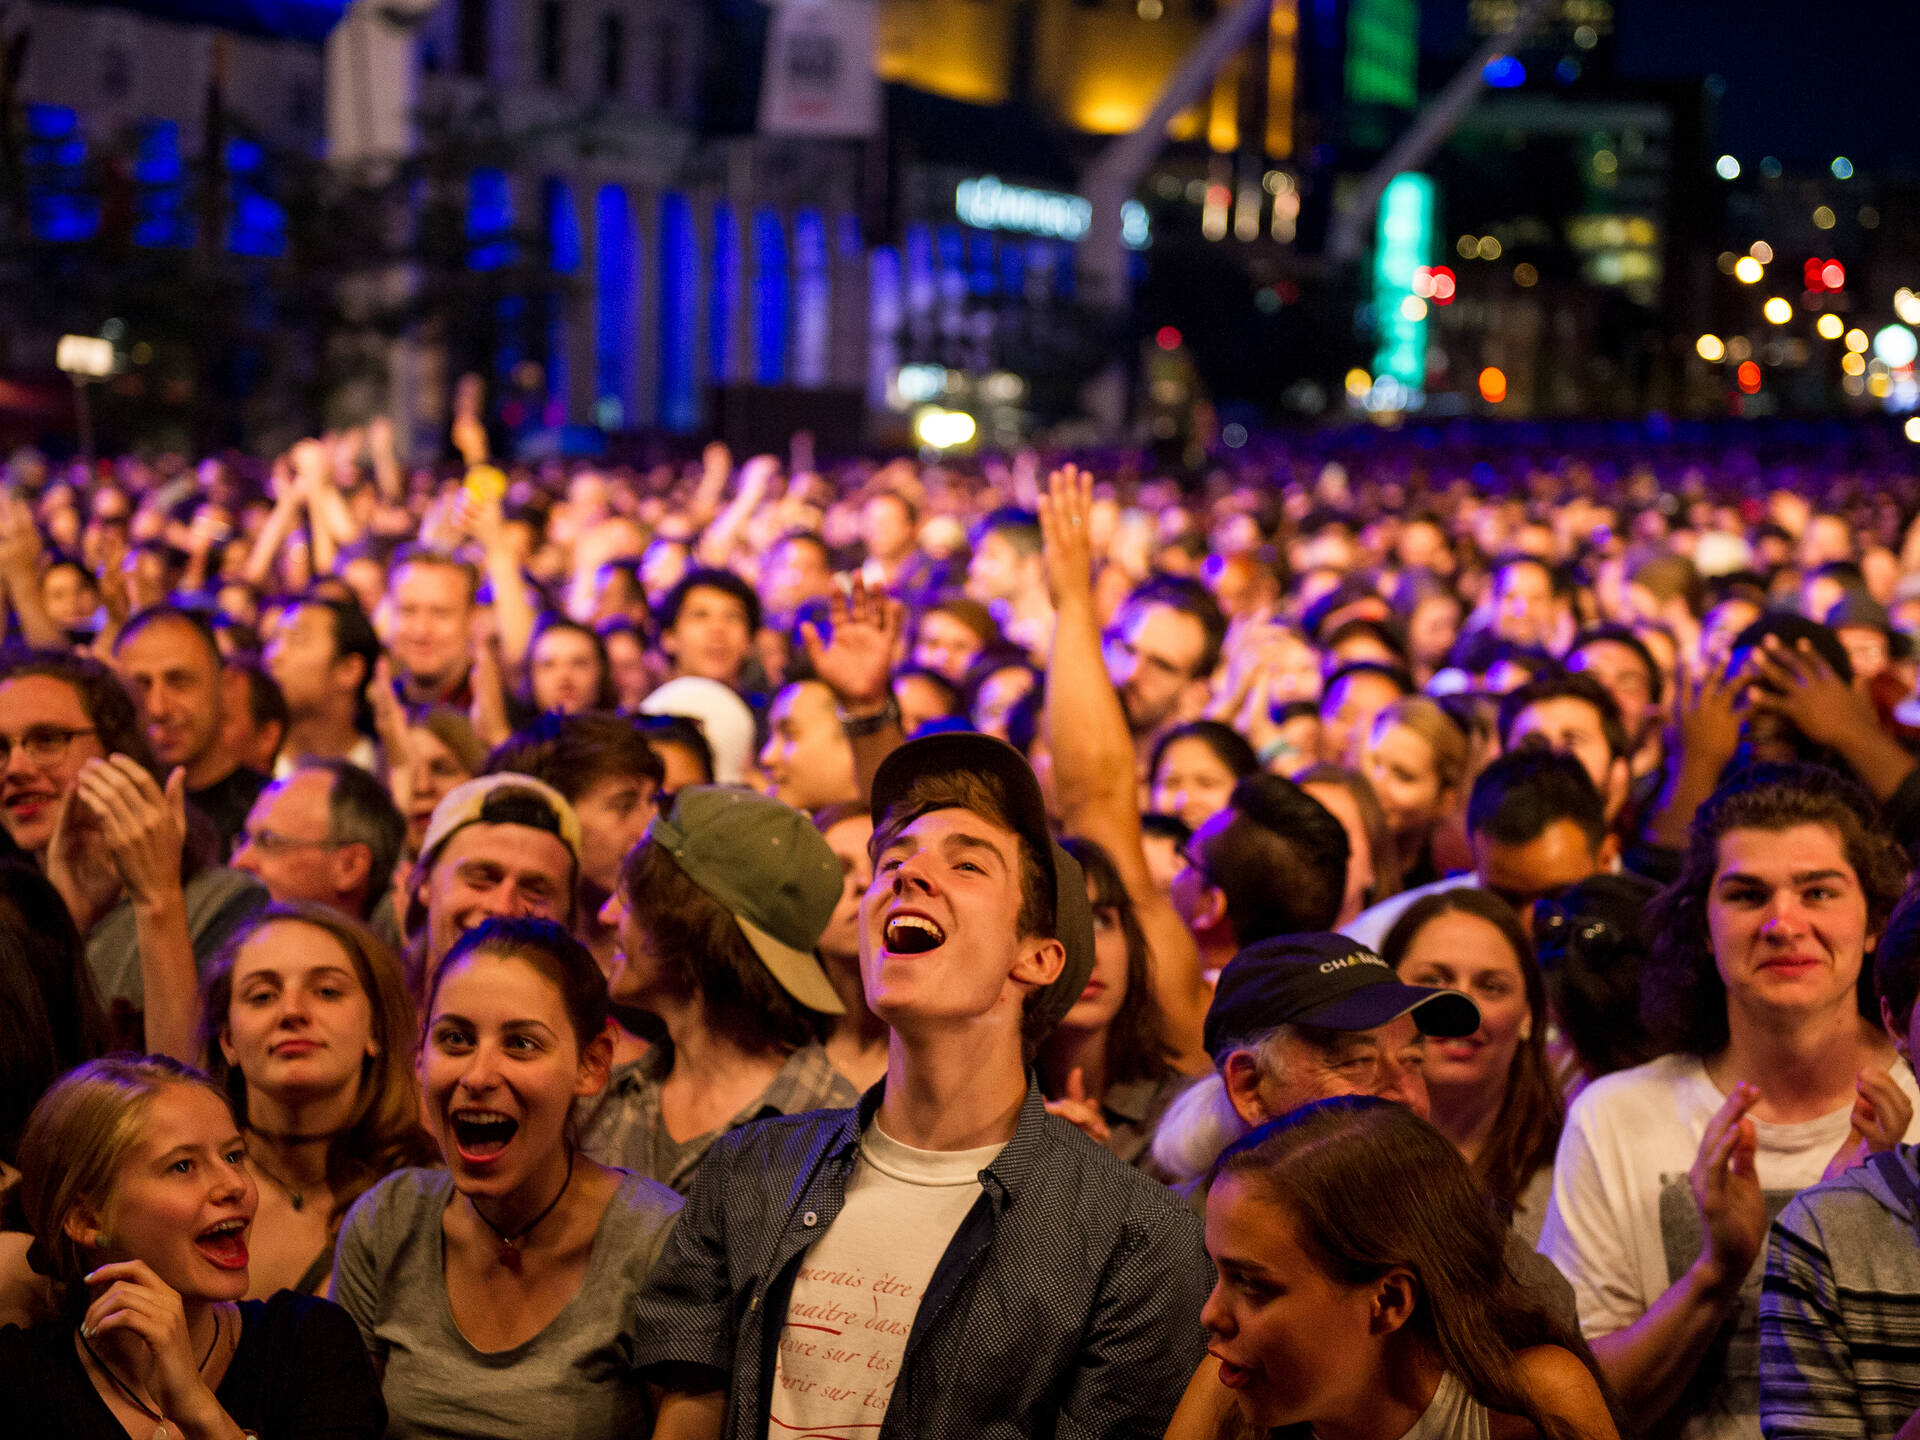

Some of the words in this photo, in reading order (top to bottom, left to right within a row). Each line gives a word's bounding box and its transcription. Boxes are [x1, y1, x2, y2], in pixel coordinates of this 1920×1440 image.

[872, 1272, 912, 1297] être
[864, 1295, 910, 1336] dans
[822, 1347, 861, 1363] sur
[867, 1350, 893, 1370] tes
[820, 1385, 857, 1402] sur
[863, 1388, 889, 1410] tes
